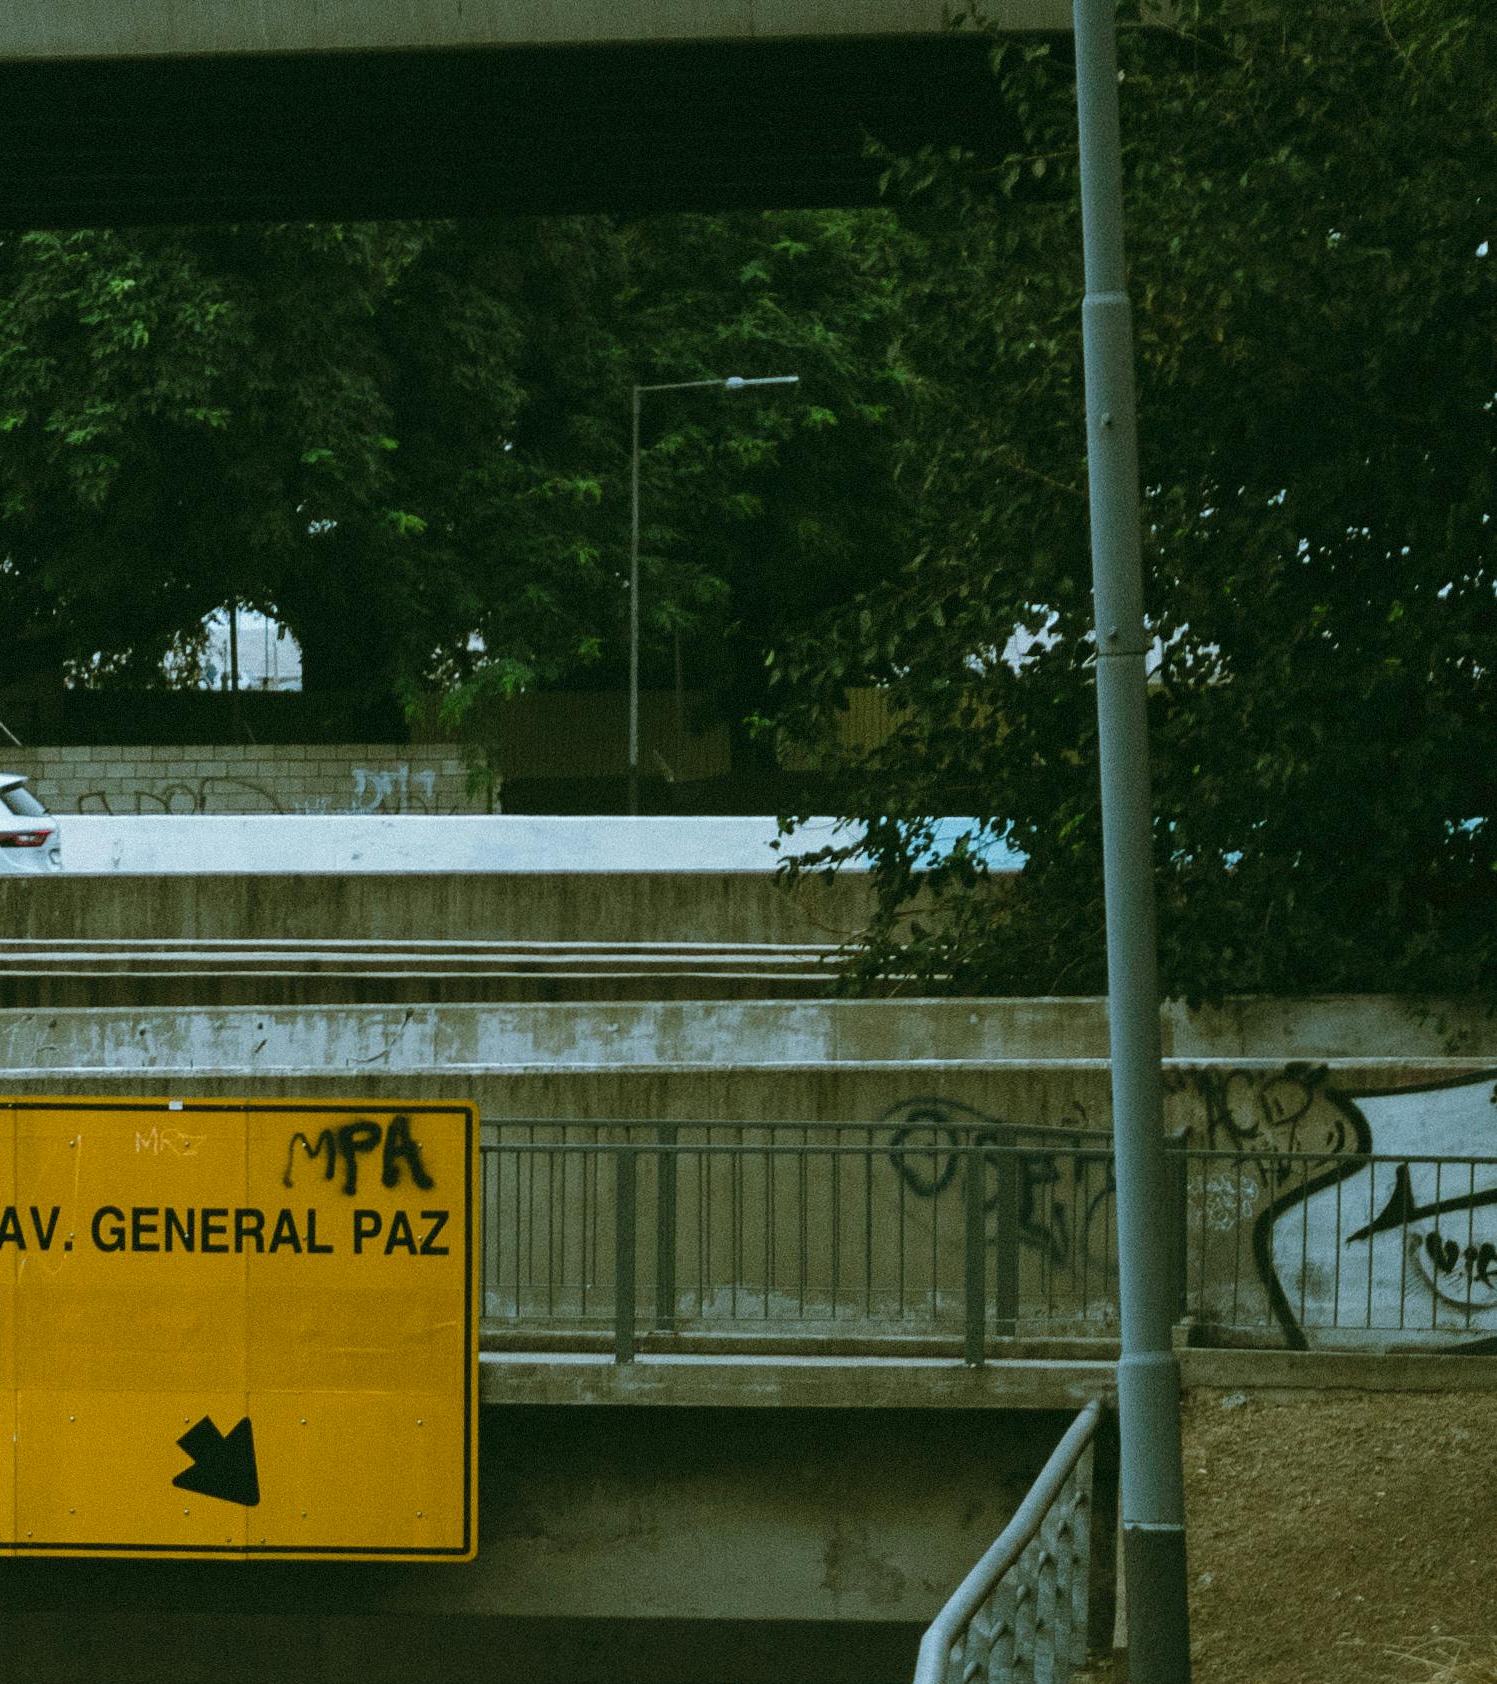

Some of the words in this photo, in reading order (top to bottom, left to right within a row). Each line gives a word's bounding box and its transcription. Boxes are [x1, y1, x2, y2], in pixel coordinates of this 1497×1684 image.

[282, 1115, 434, 1196] MPA
[90, 1206, 335, 1255] GENERAL
[353, 1209, 450, 1256] PAZ
